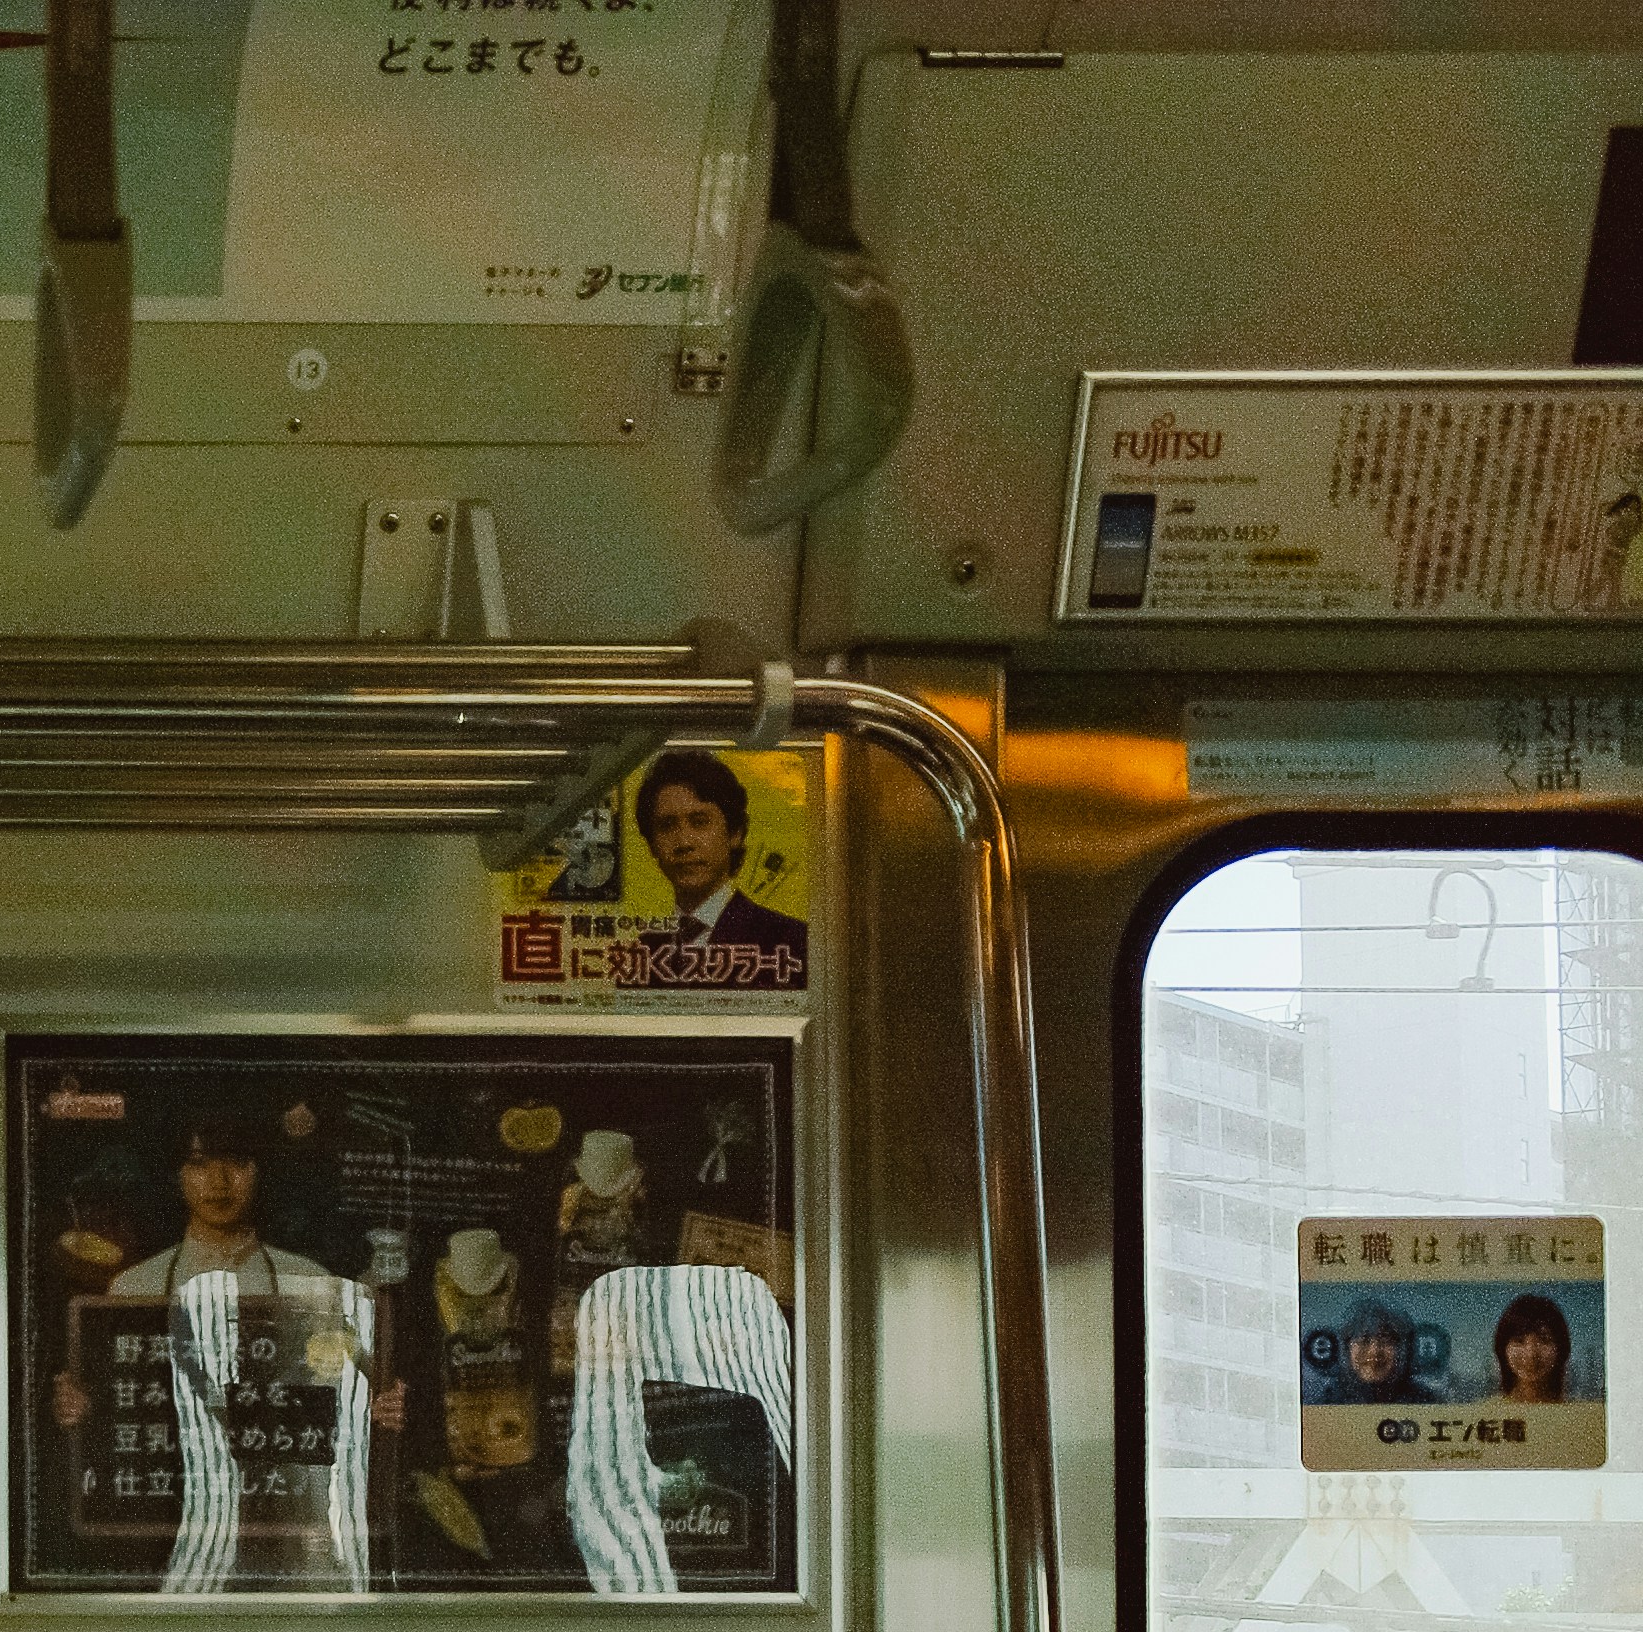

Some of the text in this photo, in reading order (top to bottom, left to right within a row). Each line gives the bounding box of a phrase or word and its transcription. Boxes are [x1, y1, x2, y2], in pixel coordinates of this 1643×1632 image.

[378, 37, 600, 77] どこまでも。
[296, 360, 320, 381] 13
[1112, 419, 1223, 467] FUJITSU
[1314, 1231, 1600, 1266] 転職は慎重に。
[1428, 1419, 1526, 1443] エン転職
[663, 1504, 730, 1536] oothie
